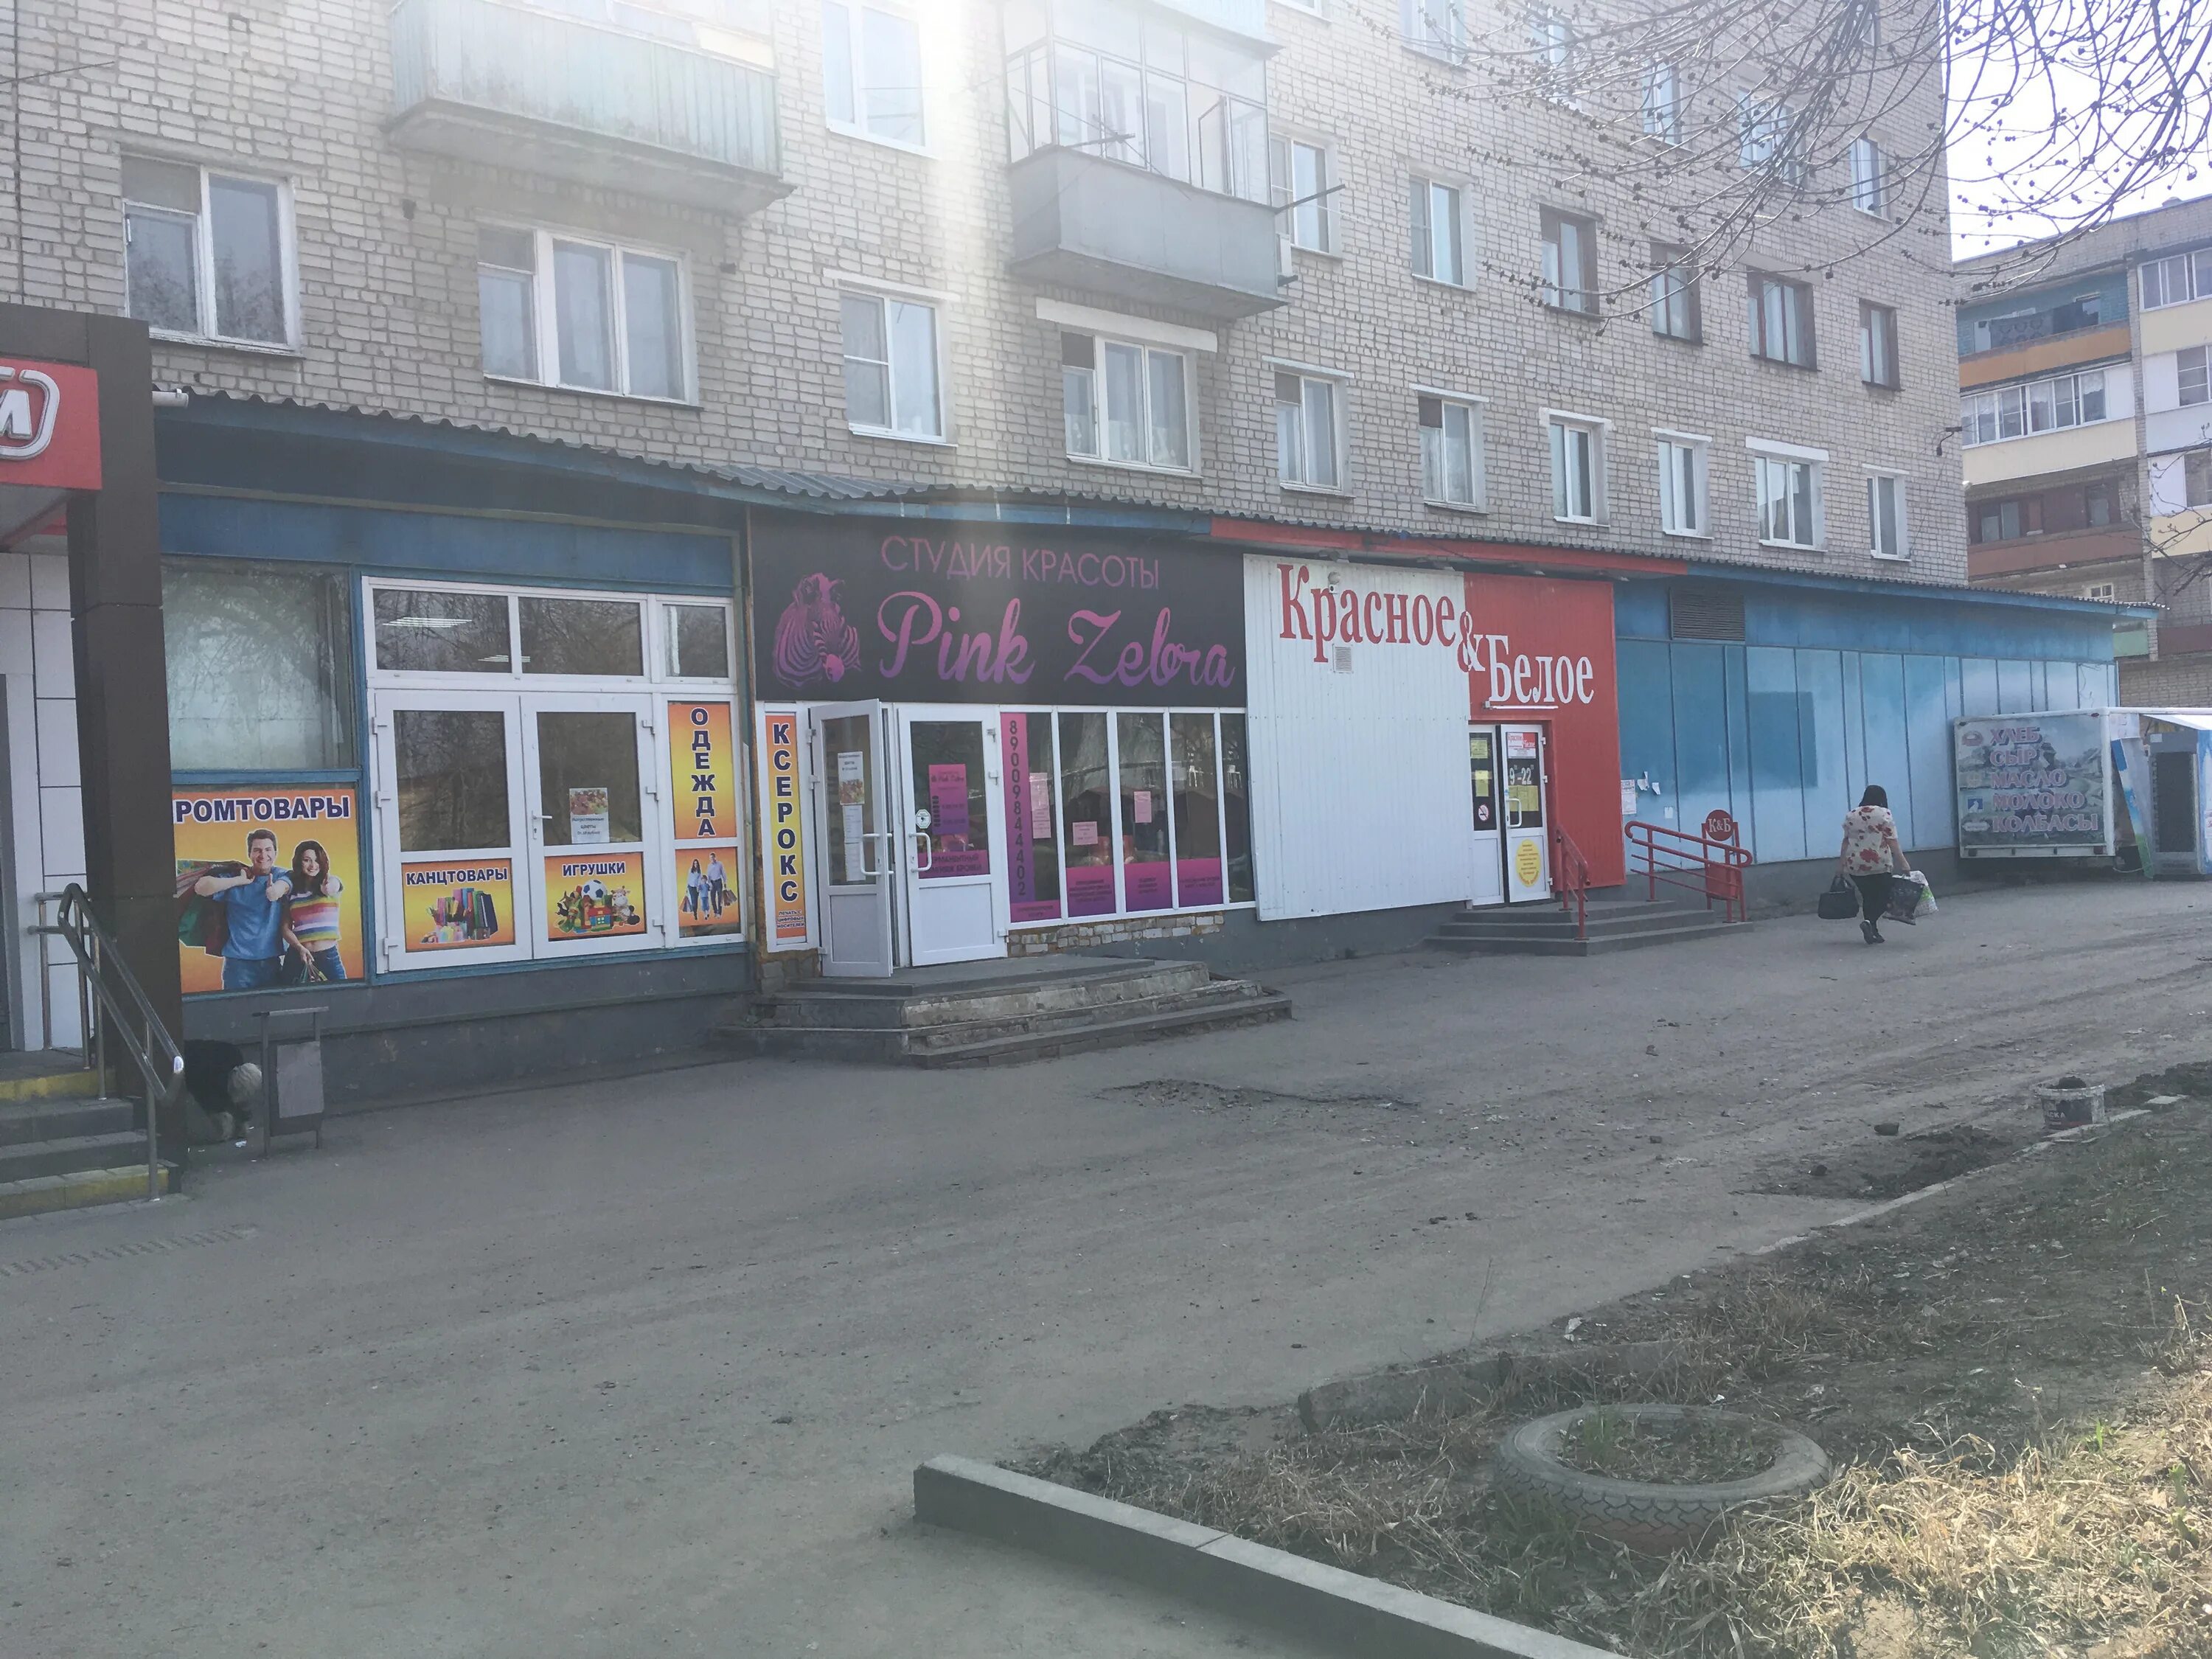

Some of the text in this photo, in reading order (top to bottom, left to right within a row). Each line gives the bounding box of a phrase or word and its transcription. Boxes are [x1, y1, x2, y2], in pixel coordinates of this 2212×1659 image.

[881, 535, 1160, 589] СТУДИЯ КРАСОТЫ
[877, 591, 1236, 687] Pink Zebra
[1276, 563, 1456, 663] Красное
[1485, 634, 1595, 704] Белое
[1990, 726, 2042, 745] ХЛЕБ
[1990, 747, 2039, 768] СЫР
[690, 708, 716, 837] ОДЕЖДА
[1992, 769, 2068, 790] МАСЛО
[173, 796, 350, 824] РОМТОВАРЫ
[1992, 791, 2087, 811] МОЛОКО
[773, 723, 798, 902] КСЕРОКС
[1992, 813, 2099, 833] КОЛБАСЫ
[406, 867, 508, 886] КАНЦТОВАРЫ
[562, 861, 626, 877] ИГРУШКИ
